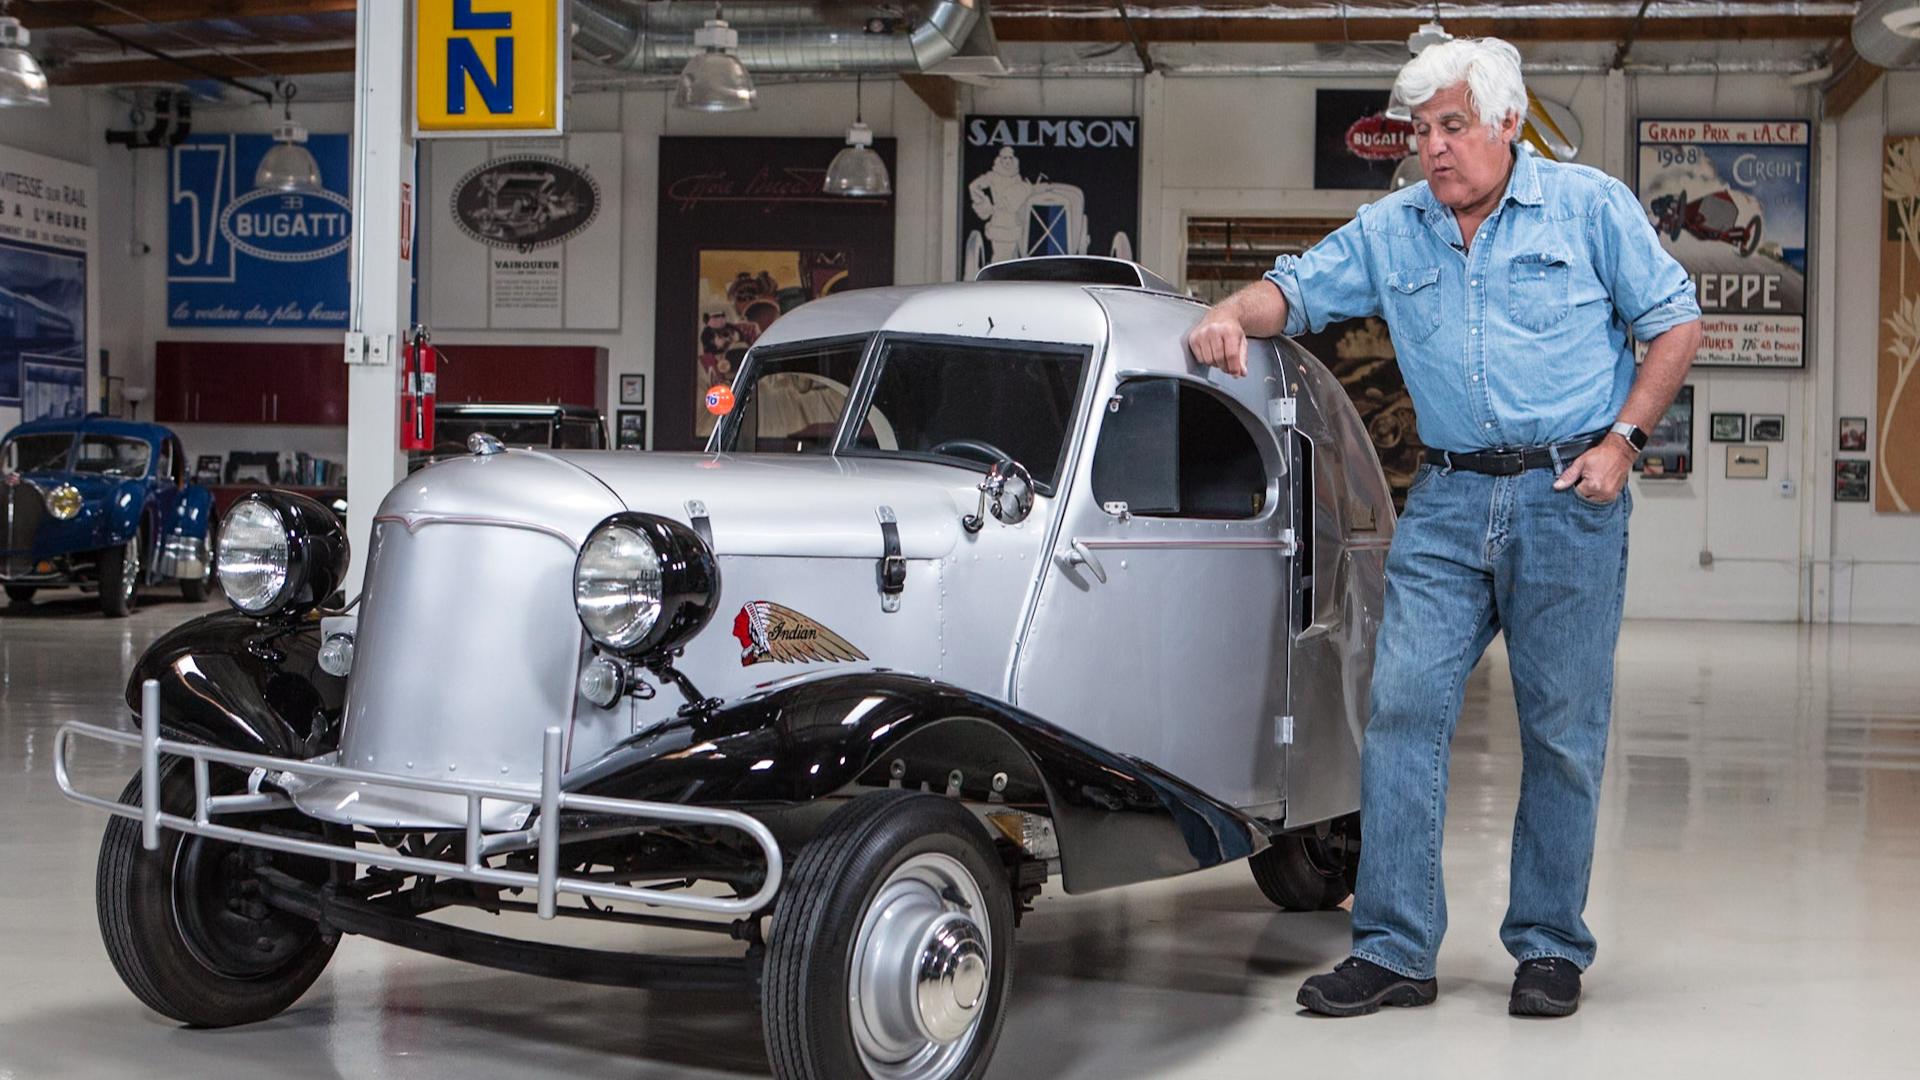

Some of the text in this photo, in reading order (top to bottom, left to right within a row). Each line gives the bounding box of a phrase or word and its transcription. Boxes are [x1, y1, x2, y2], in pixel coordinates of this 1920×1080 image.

[967, 119, 1136, 148] SALMSON
[1648, 123, 1696, 143] GRAND
[1703, 124, 1730, 143] PRIX
[1732, 153, 1803, 187] CIRCUIT
[173, 144, 226, 265] 57
[236, 213, 346, 237] BUGATTI
[494, 260, 560, 269] VAINQUEUR
[1690, 273, 1782, 308] EPPE
[768, 622, 818, 642] Indian
